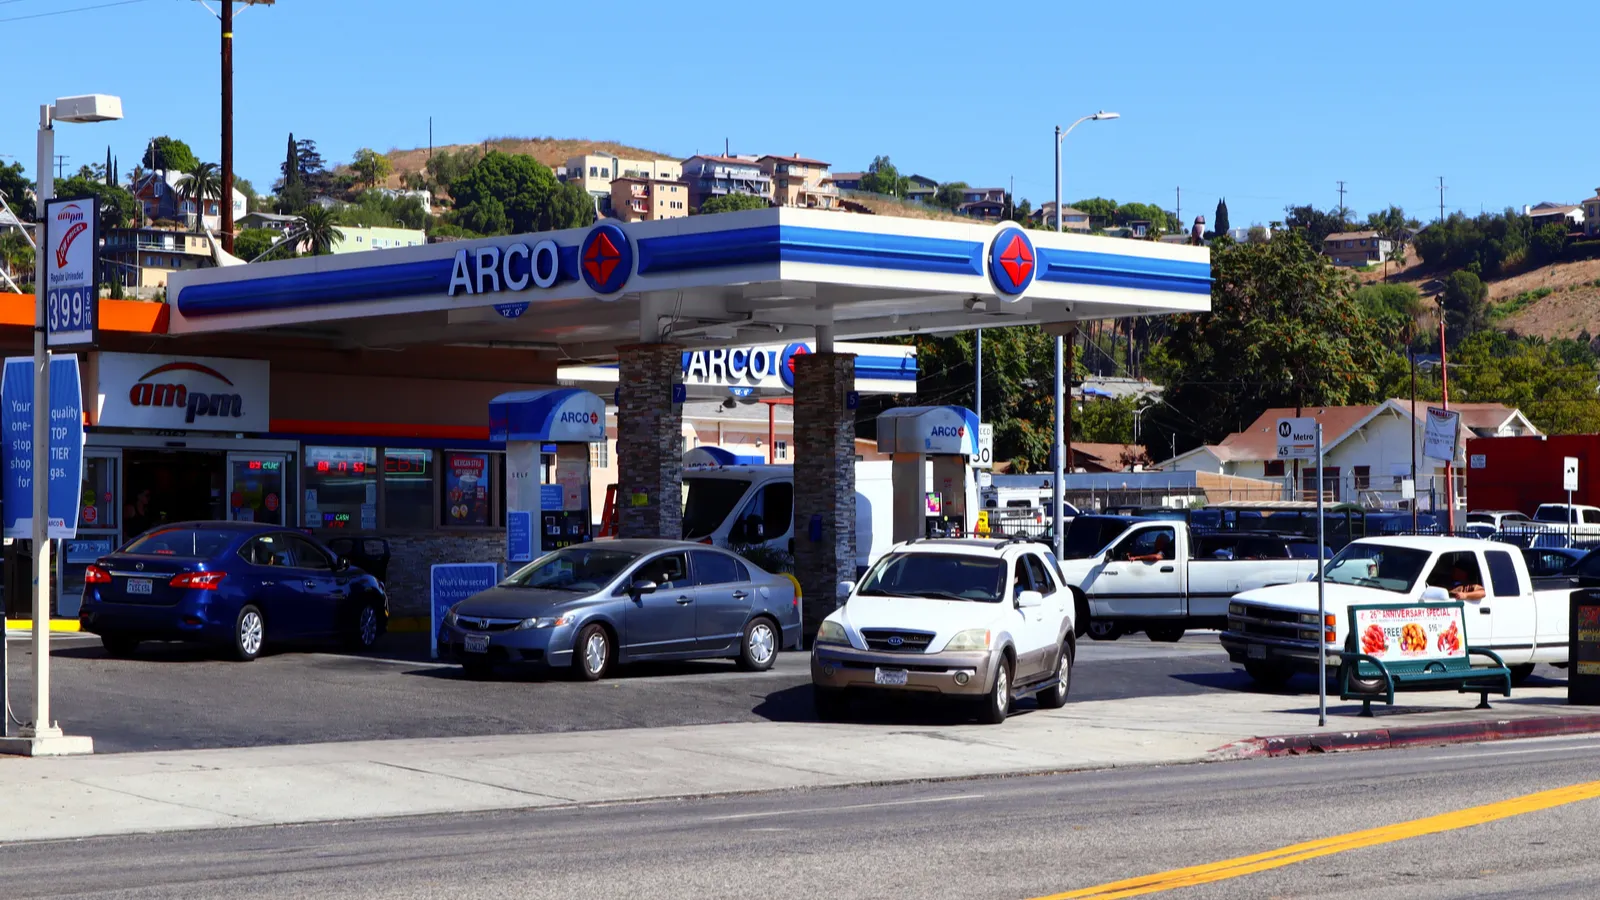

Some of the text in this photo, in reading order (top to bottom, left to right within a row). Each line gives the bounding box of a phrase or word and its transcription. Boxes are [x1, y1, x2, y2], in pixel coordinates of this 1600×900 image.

[57, 212, 84, 224] ampm
[448, 240, 559, 296] ARCO
[50, 271, 84, 284] Regular Unleaded
[49, 291, 82, 331] 399
[688, 346, 770, 380] ARCO
[676, 387, 682, 397] 7
[12, 400, 31, 412] Your
[129, 383, 243, 423] ampm
[849, 396, 856, 405] 5
[51, 406, 78, 420] quality
[560, 412, 589, 423] ARCO
[12, 422, 31, 431] one-
[931, 426, 957, 437] ARCO
[51, 427, 68, 440] TOP
[1293, 433, 1314, 441] Metro
[13, 439, 31, 452] stop
[1279, 446, 1289, 456] 45
[10, 457, 31, 471] shop
[50, 468, 67, 480] gas.
[18, 476, 31, 488] for
[307, 491, 315, 500] A
[439, 578, 488, 586] What's the secret
[1383, 608, 1425, 618] ANNIVERSARY
[1426, 607, 1451, 617] SPECIAL
